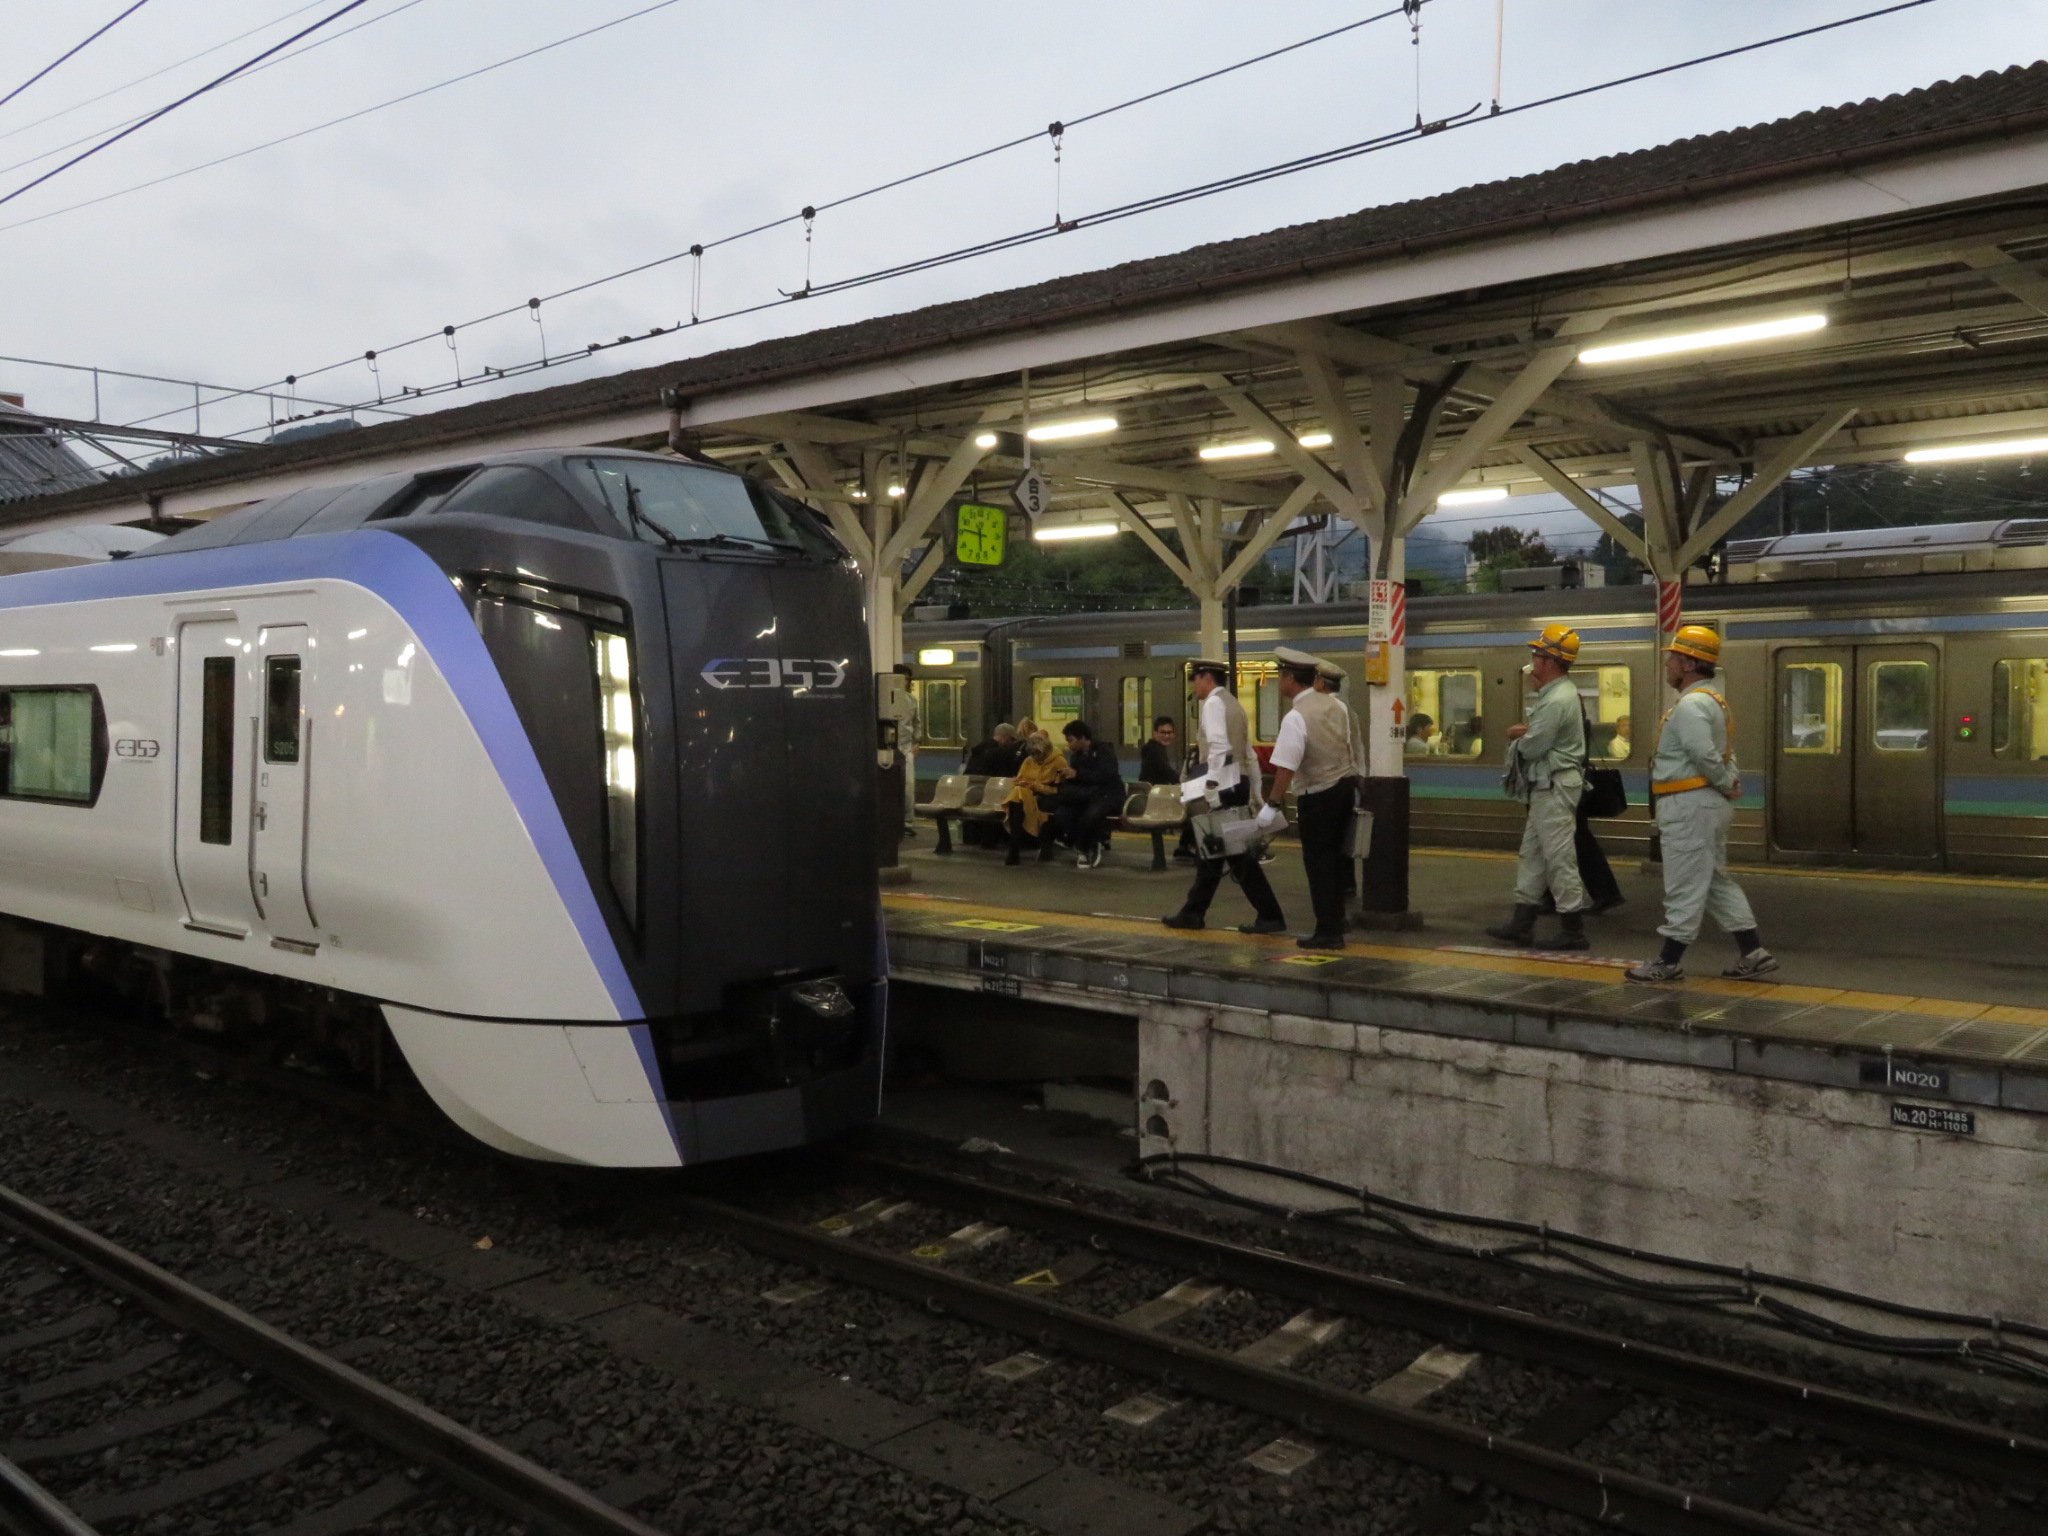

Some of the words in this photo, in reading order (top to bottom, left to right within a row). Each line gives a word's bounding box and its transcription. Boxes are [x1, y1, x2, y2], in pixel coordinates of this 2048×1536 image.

[700, 658, 847, 689] E353
[114, 739, 160, 758] E353
[273, 741, 295, 755] S205
